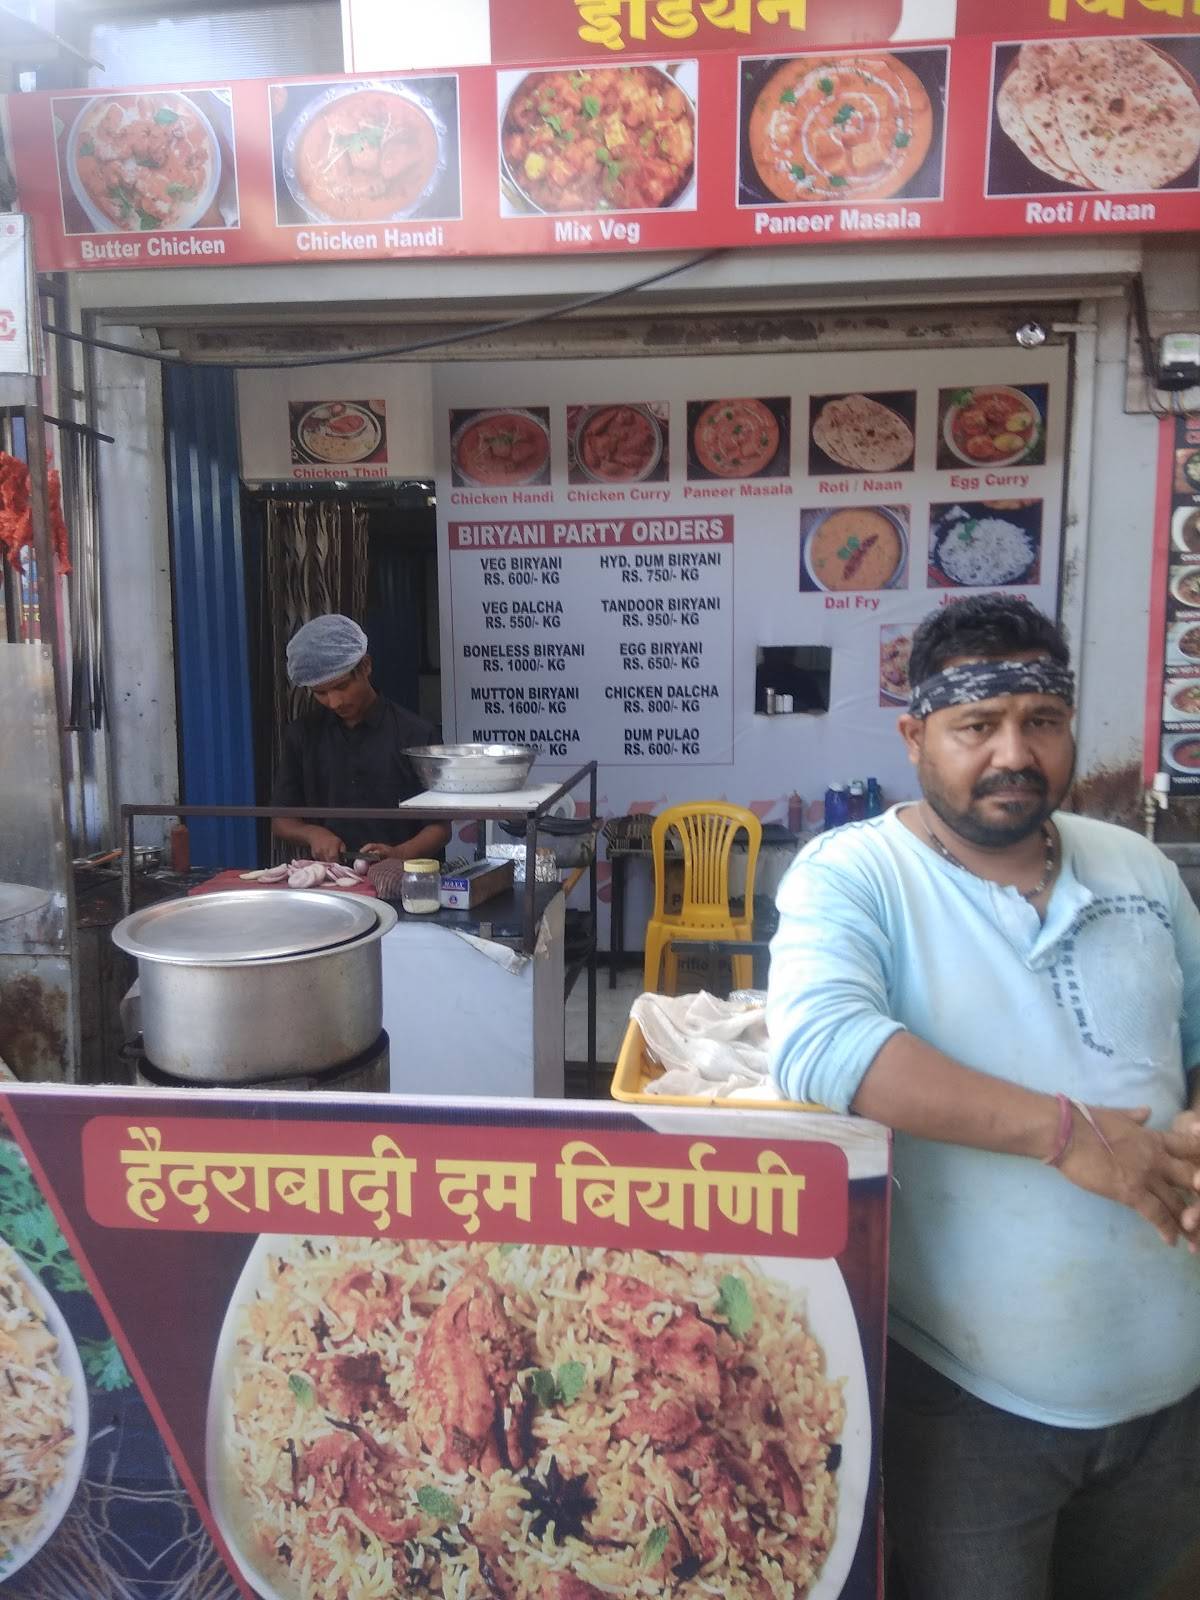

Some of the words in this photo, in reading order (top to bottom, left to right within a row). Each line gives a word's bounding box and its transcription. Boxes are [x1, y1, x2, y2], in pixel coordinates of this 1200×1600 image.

[1025, 203, 1074, 223] Roti
[1079, 202, 1087, 222] /
[1093, 201, 1156, 221] Naan
[754, 212, 833, 234] Paneer
[839, 208, 921, 230] Masala
[296, 231, 376, 252] Chicken
[384, 227, 443, 248] Handi
[554, 222, 592, 242] Mix
[598, 219, 641, 244] Veg
[80, 240, 141, 259] Butter
[147, 236, 225, 256] Chicken
[293, 468, 349, 479] Chicken
[353, 467, 388, 478] Thali
[950, 474, 980, 490] Egg
[987, 472, 1030, 488] Curry
[567, 488, 625, 502] Chicken
[630, 486, 671, 501] Curry
[683, 485, 735, 499] Paneer
[740, 482, 793, 498] Masala
[818, 479, 850, 494] Roti
[863, 478, 903, 492] Naan
[451, 490, 509, 505] Chicken
[512, 489, 554, 503] Handi
[457, 524, 546, 546] BIRYANI
[553, 521, 625, 544] PARTY
[631, 518, 724, 543] ORDERS
[480, 558, 508, 570] VEG
[510, 556, 562, 570] BIRYANI
[600, 556, 629, 569] HYD.
[635, 555, 664, 568] DUM
[668, 553, 721, 567] BIRYANI
[484, 572, 505, 586] RS.
[508, 571, 538, 585] 600/-
[541, 571, 560, 584] KG
[622, 570, 643, 584] RS.
[646, 569, 677, 582] 750/-
[681, 568, 700, 582] KG
[482, 601, 508, 614] VEG
[512, 600, 564, 614] DALCHA
[601, 599, 664, 613] TANDOOR
[668, 597, 721, 611] BIRYANI
[824, 595, 850, 610] Dal
[855, 595, 880, 612] Fry
[485, 616, 506, 629] RS.
[509, 615, 539, 629] 550/-
[542, 614, 561, 628] KG
[622, 613, 643, 627] RS.
[647, 612, 678, 626] 950/-
[681, 611, 700, 625] KG
[463, 645, 530, 658] BONELESS
[533, 644, 585, 657] BIRYANI
[619, 643, 646, 656] EGG
[650, 642, 703, 655] BIRYANI
[482, 658, 504, 672] RS.
[507, 658, 544, 672] 1000/-
[547, 657, 566, 671] KG
[623, 657, 643, 670] RS.
[647, 656, 678, 670] 650/-
[681, 655, 700, 669] KG
[470, 687, 525, 701] MUTTON
[528, 686, 580, 700] BIRYANI
[604, 685, 663, 699] CHICKEN
[667, 684, 720, 699] DALCHA
[484, 702, 505, 714] RS.
[510, 701, 545, 715] 1600/-
[548, 700, 567, 714] KG
[623, 700, 644, 714] RS.
[647, 699, 678, 713] 800/-
[681, 698, 700, 713] KG
[472, 730, 526, 743] MUTTON
[529, 728, 581, 742] DALCHA
[623, 729, 653, 742] DUM
[656, 727, 700, 742] PULAO
[549, 743, 568, 756] KG
[623, 742, 644, 756] RS.
[647, 741, 678, 756] 600/-
[681, 741, 701, 755] KG
[120, 1126, 417, 1231] हैदराबादी
[435, 1158, 536, 1234] दम
[556, 1141, 806, 1236] बिर्याणी
